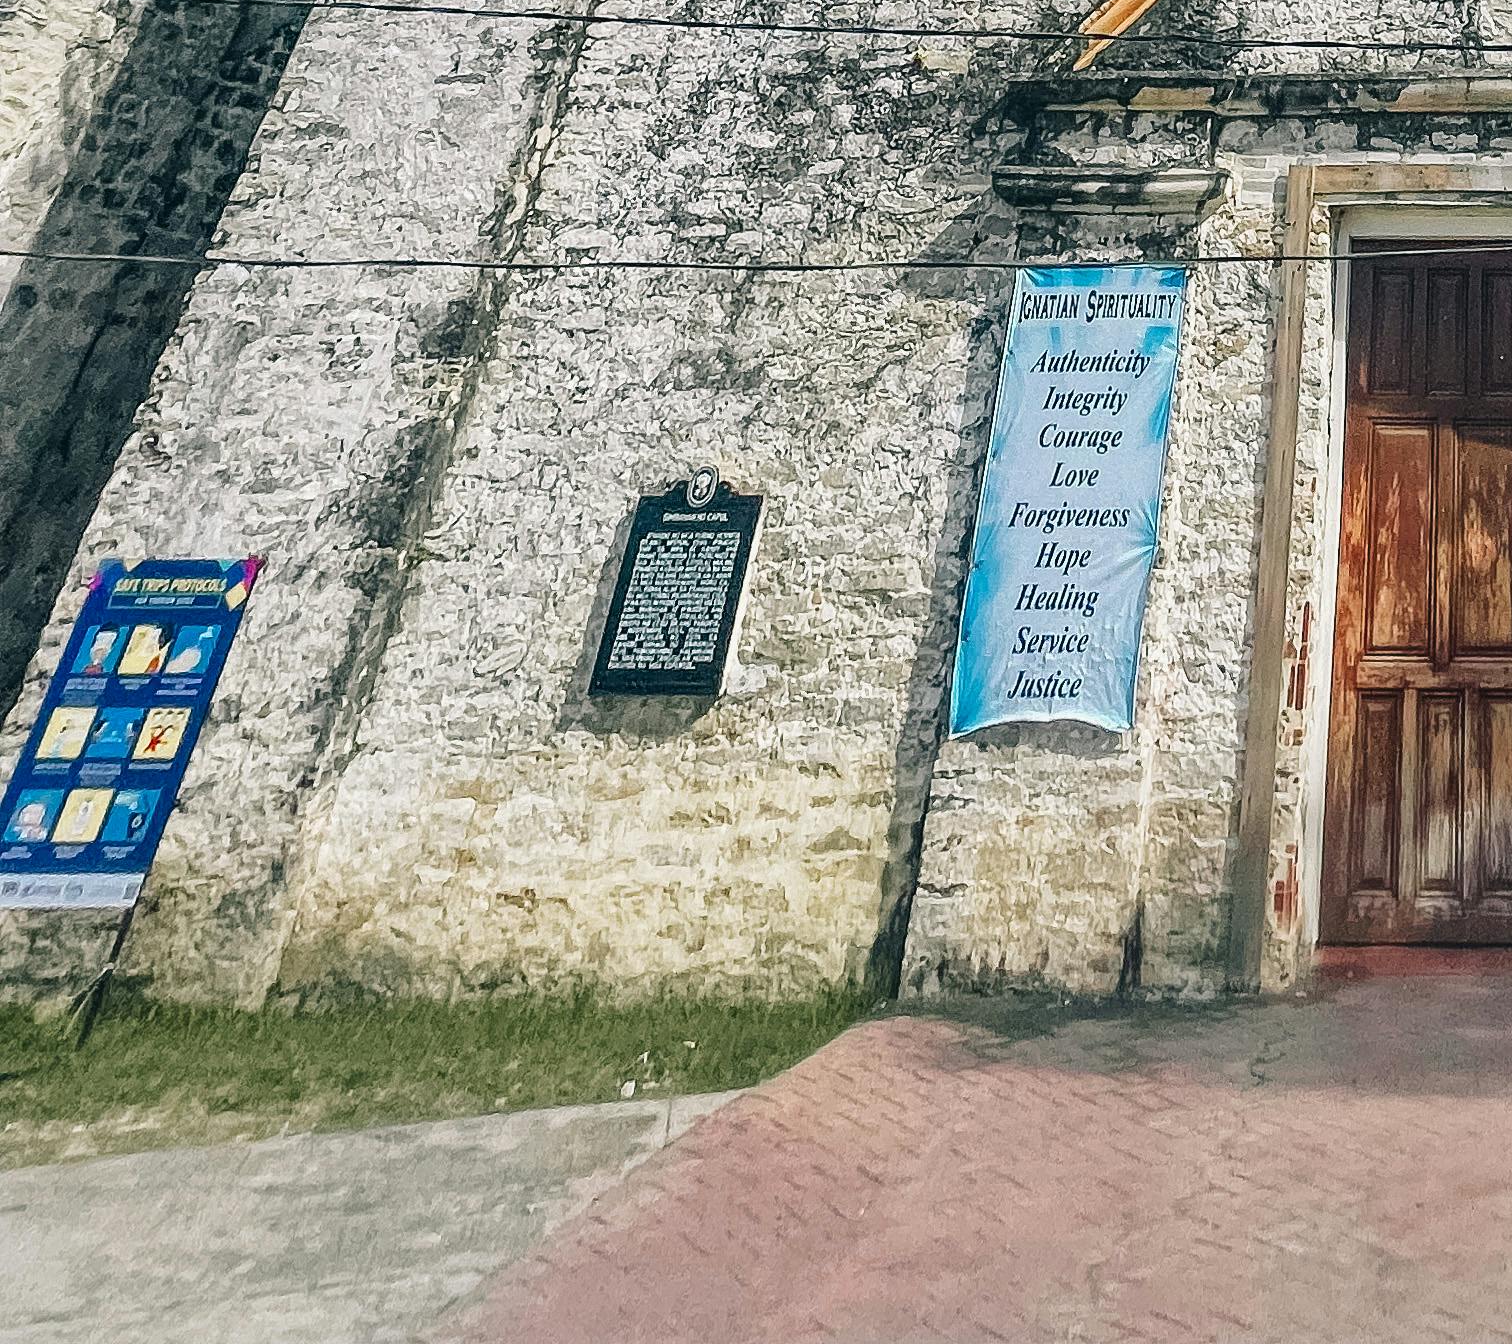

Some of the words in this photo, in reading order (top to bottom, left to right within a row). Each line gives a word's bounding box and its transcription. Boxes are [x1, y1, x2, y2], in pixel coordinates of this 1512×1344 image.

[1030, 348, 1152, 379] Authenticity
[1042, 385, 1128, 416] Integrity
[1039, 423, 1124, 455] Courage
[1048, 462, 1100, 488] Love
[1007, 501, 1131, 534] Forgiveness
[1033, 541, 1092, 576] Hope
[1013, 583, 1100, 618] Healing
[1011, 625, 1090, 655] Service
[1006, 669, 1083, 700] Justice
